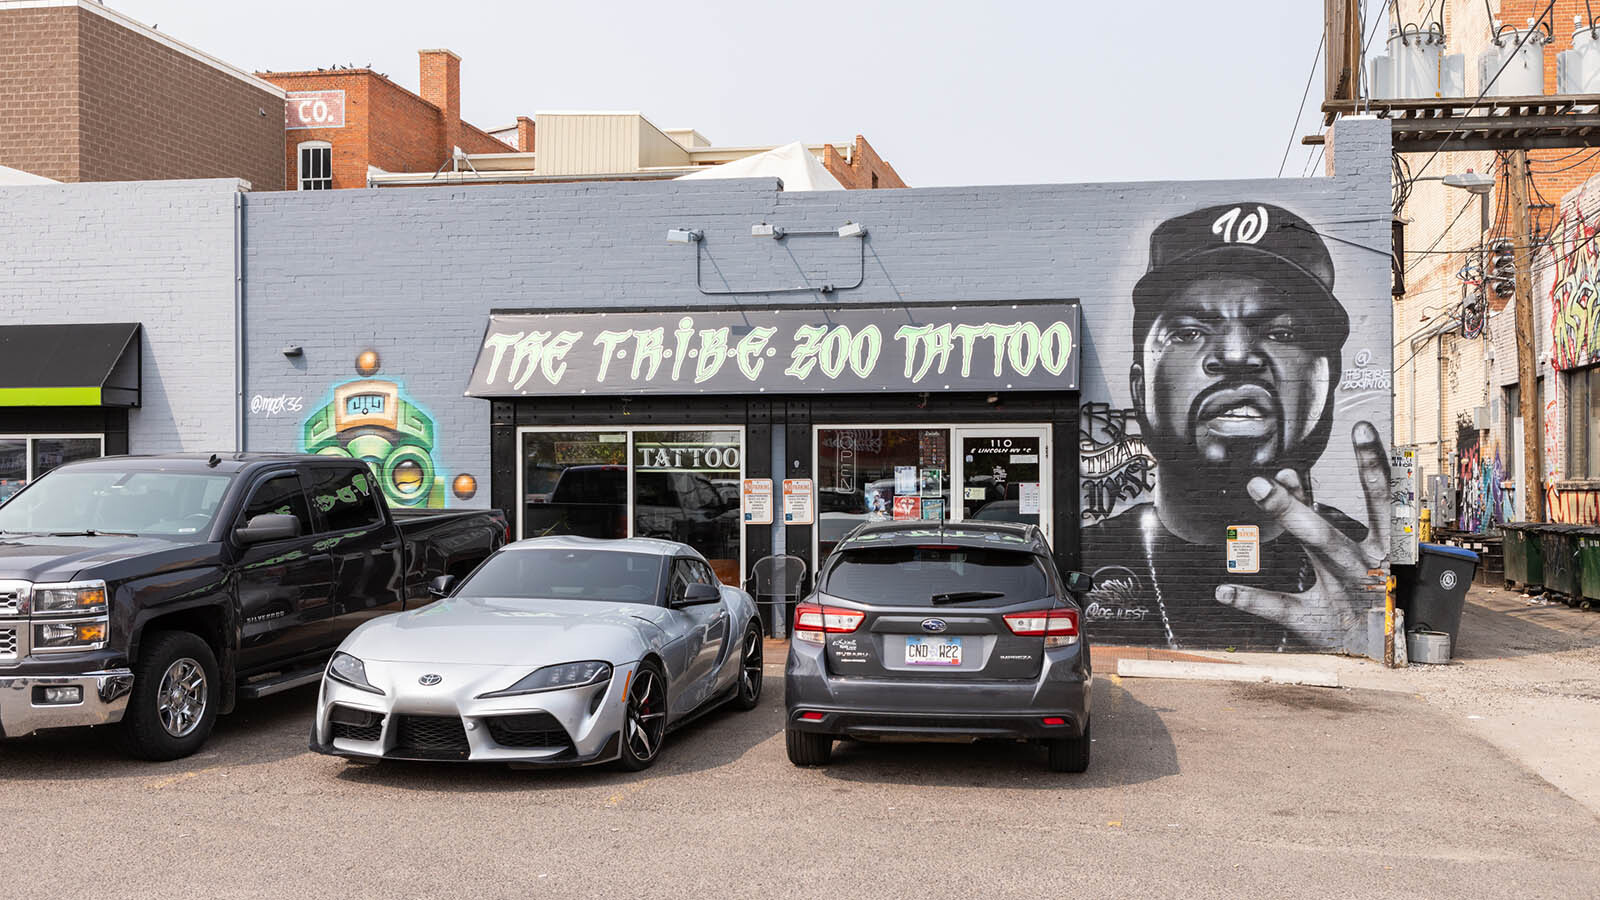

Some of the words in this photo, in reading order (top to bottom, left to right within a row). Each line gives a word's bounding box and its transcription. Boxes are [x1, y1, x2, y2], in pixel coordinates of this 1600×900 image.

[298, 101, 334, 123] CO.
[485, 330, 583, 390] THE
[785, 324, 882, 381] ZOO
[894, 321, 1072, 383] TATTOO
[991, 439, 1012, 447] 110
[637, 447, 740, 468] TATTOO
[909, 644, 928, 658] CND
[939, 645, 959, 659] W22
